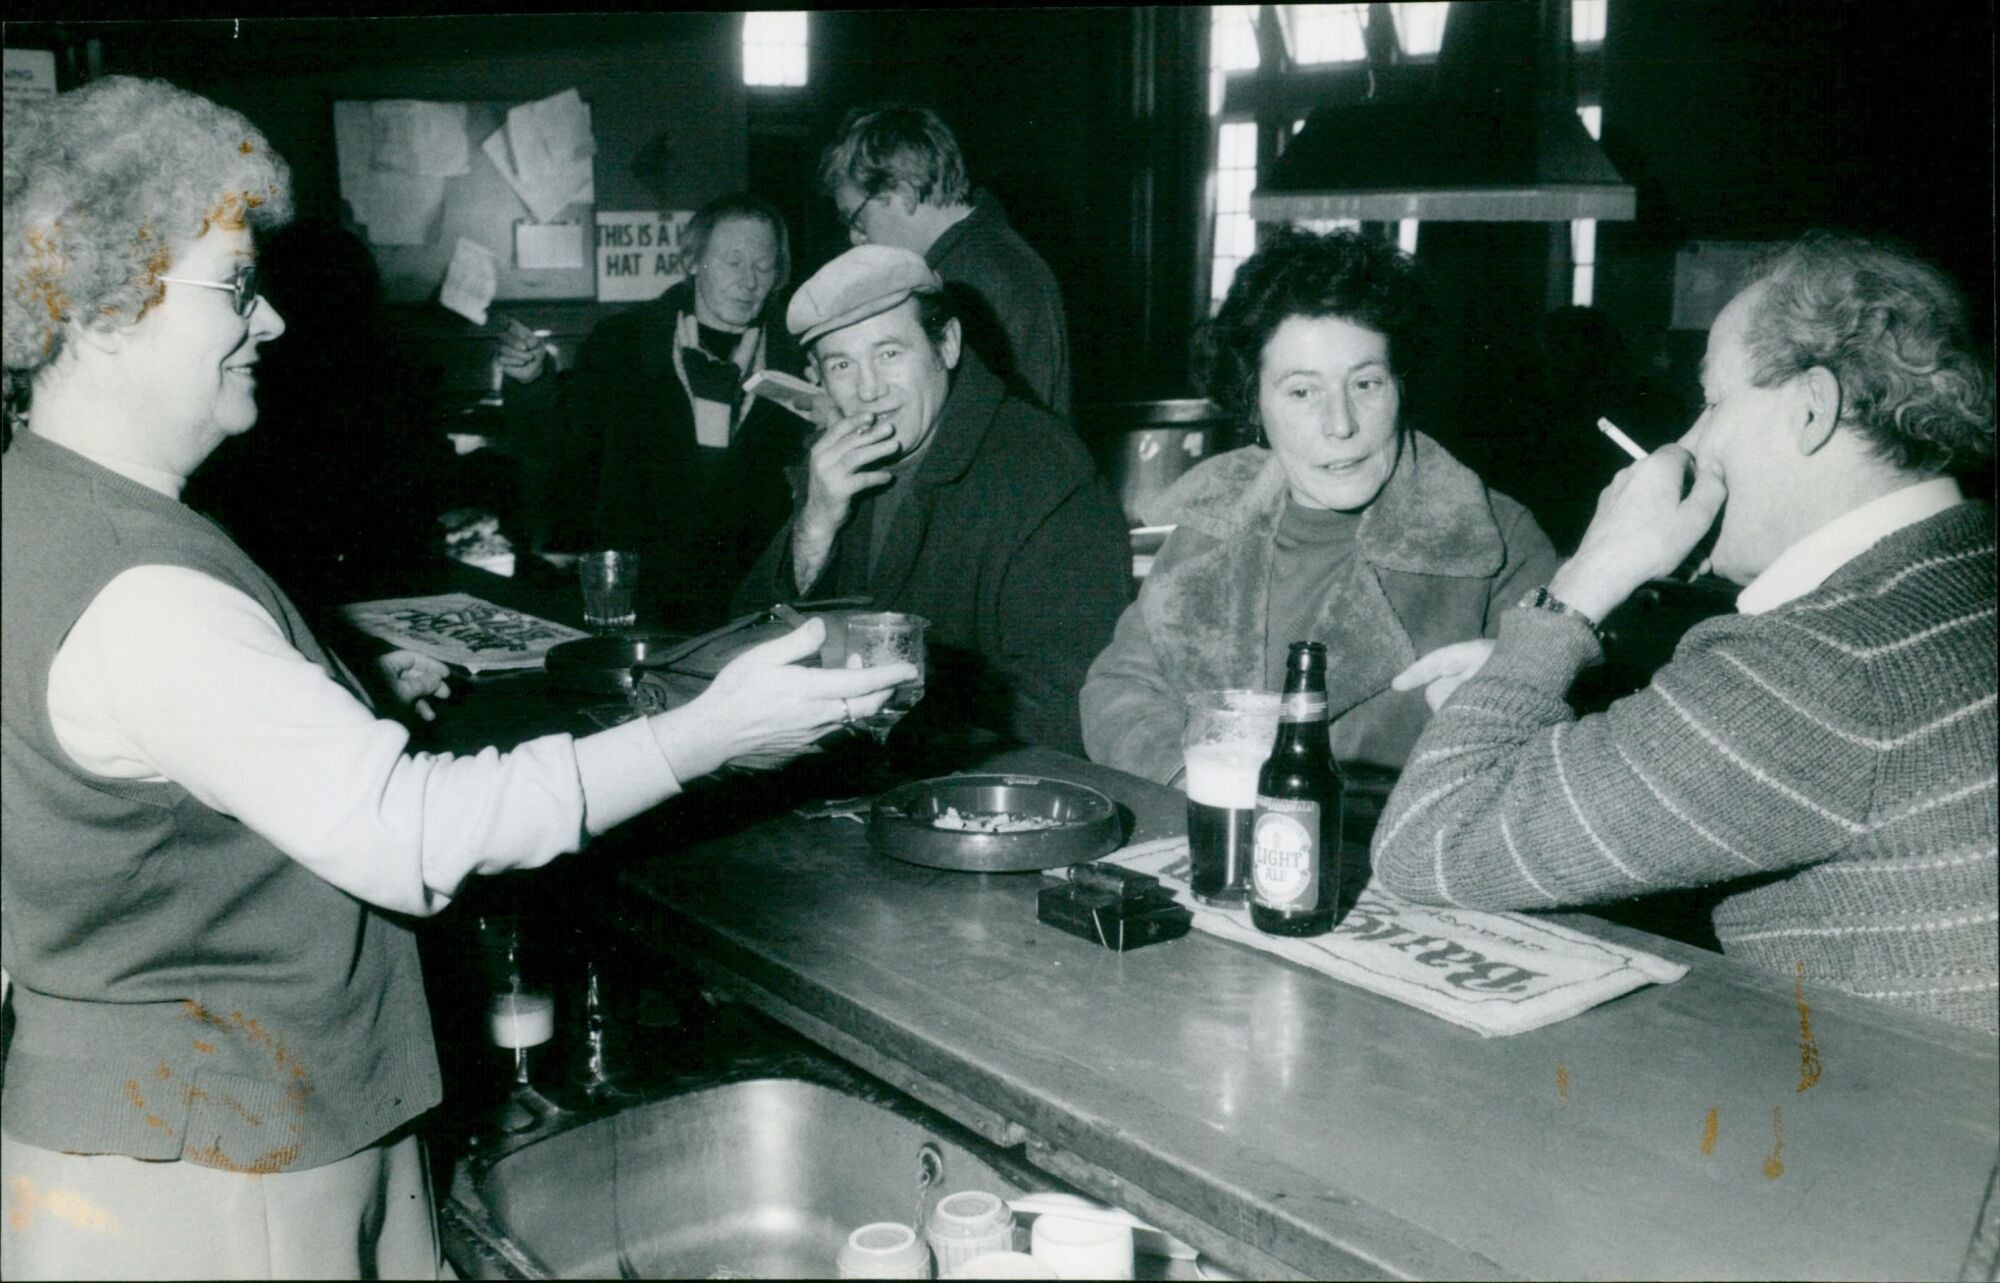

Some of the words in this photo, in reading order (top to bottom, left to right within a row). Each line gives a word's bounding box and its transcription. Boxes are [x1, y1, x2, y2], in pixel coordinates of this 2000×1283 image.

[595, 223, 634, 247] THIS
[638, 223, 653, 247] IS
[657, 223, 671, 247] A
[606, 252, 642, 276] HAT
[655, 252, 684, 276] AR
[1255, 846, 1303, 869] LIGHT
[1264, 867, 1287, 883] ALE
